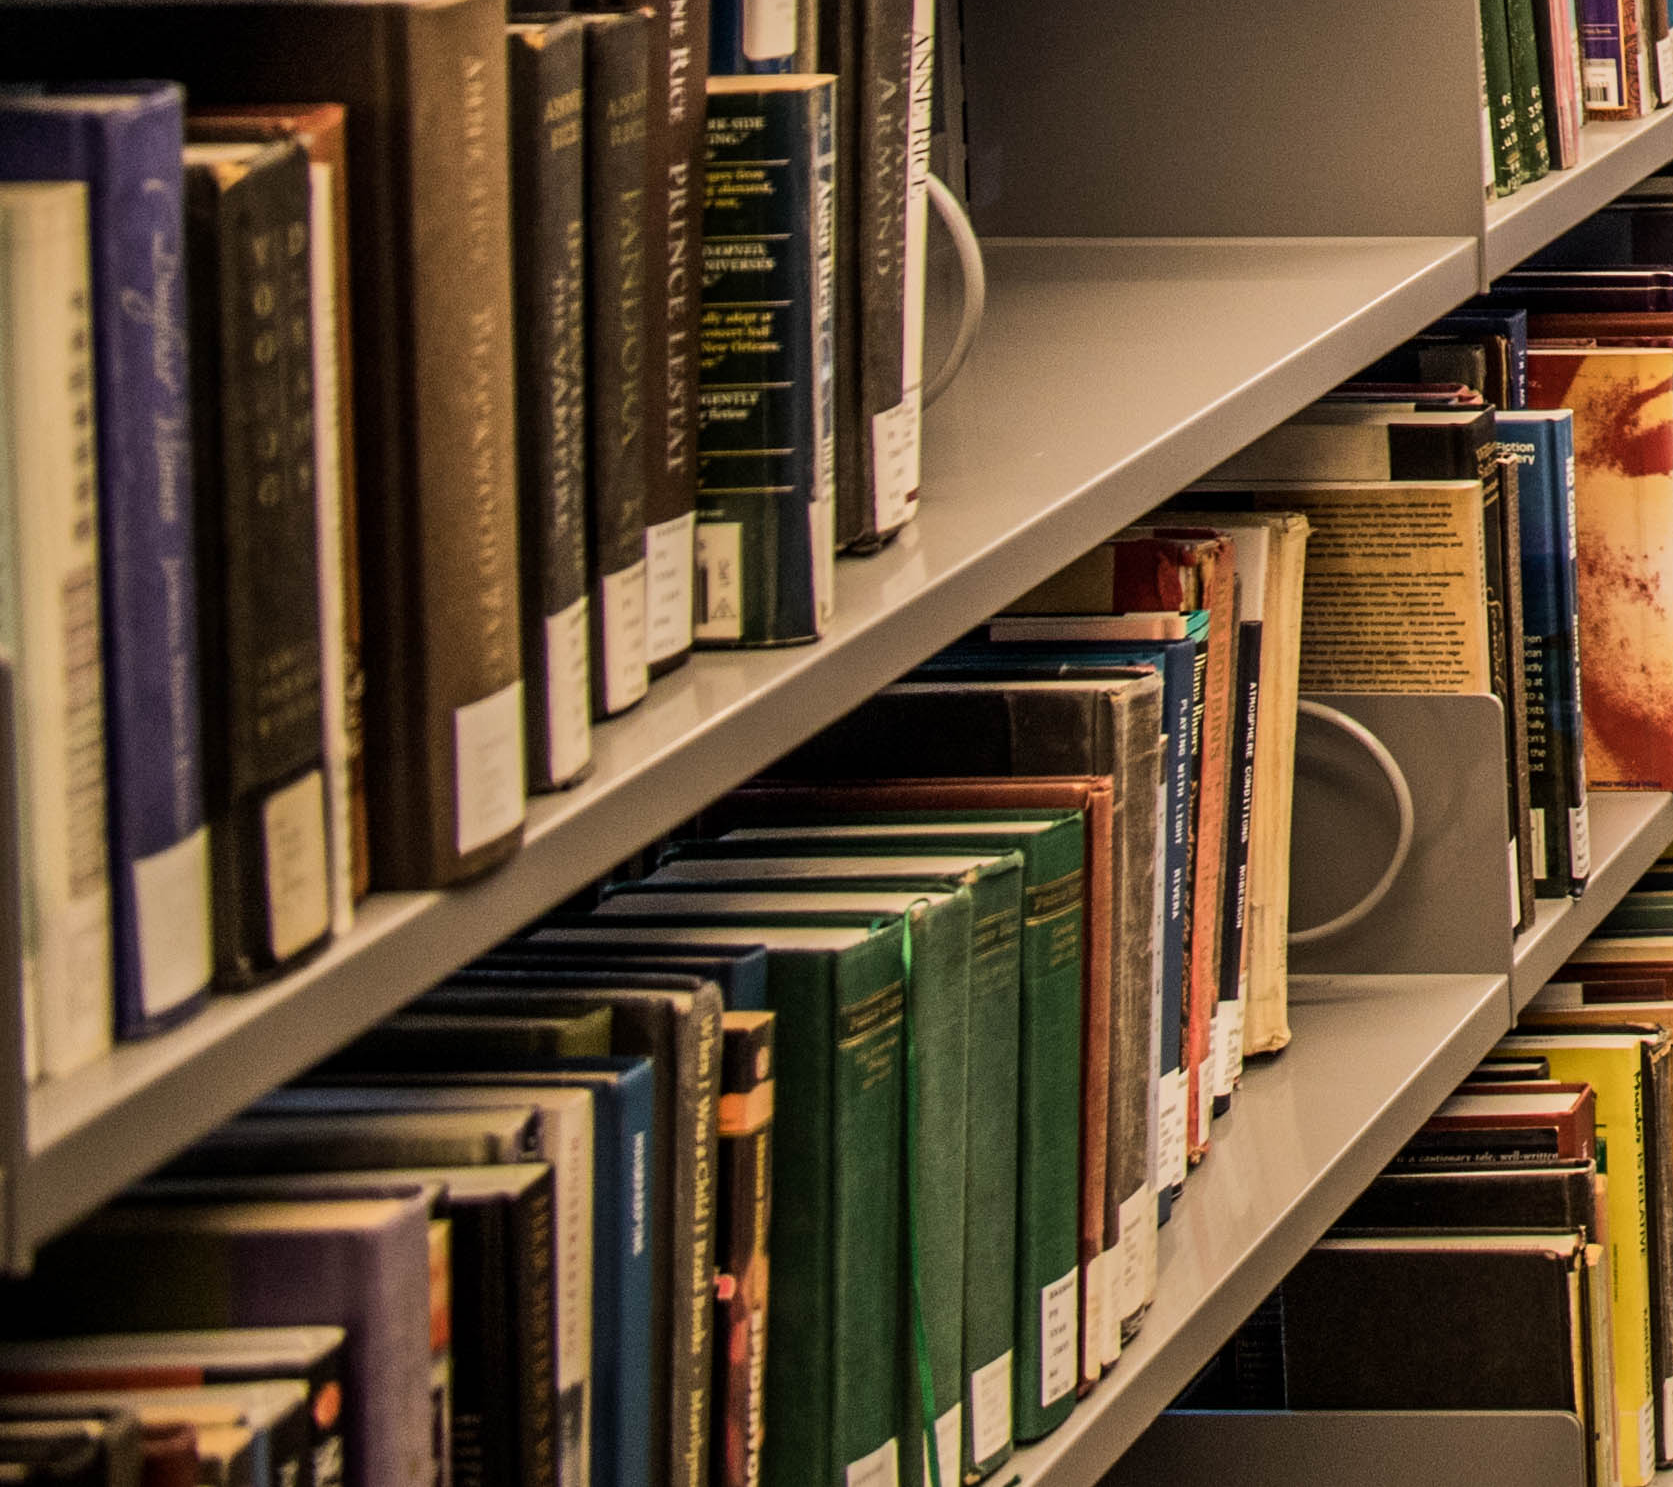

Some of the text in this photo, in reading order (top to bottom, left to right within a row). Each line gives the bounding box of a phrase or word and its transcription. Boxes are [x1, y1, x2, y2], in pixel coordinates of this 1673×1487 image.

[668, 47, 691, 122] RICE
[667, 162, 690, 318] PRINCE
[667, 333, 689, 474] LESTAT
[1171, 700, 1188, 919] PLAYING WITH LIGHT RIVERA
[1236, 682, 1258, 929] ATMOSPHERE CONDITIONS ROBERSON
